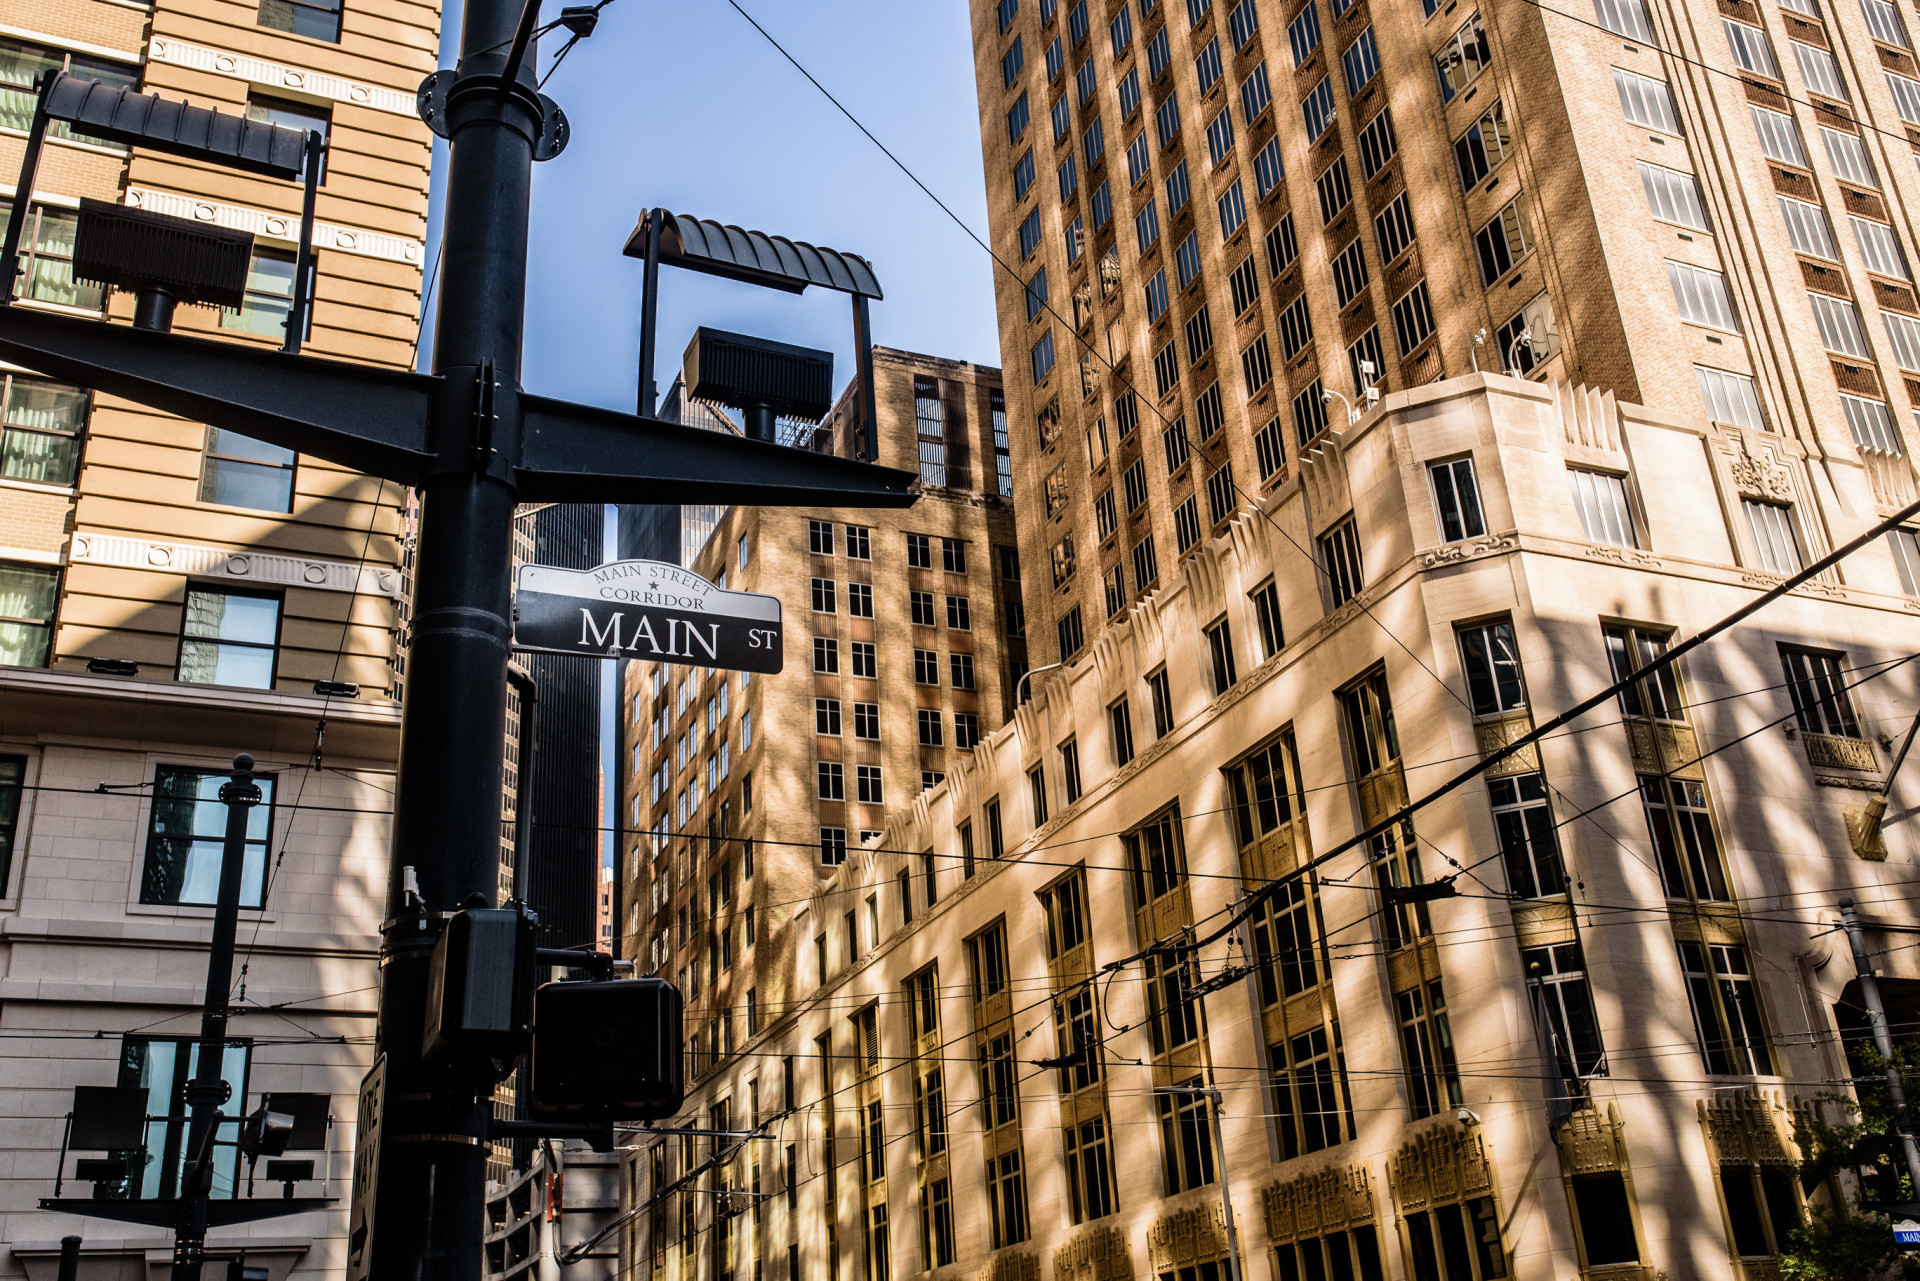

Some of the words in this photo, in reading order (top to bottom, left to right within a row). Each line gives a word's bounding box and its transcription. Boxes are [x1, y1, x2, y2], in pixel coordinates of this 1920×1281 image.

[593, 565, 641, 584] MAIN
[649, 565, 714, 596] STREET
[599, 586, 705, 610] CORRIDOR
[577, 607, 720, 660] MAIN
[748, 628, 777, 650] ST
[360, 1079, 380, 1142] ONE
[354, 1138, 376, 1203] WAY
